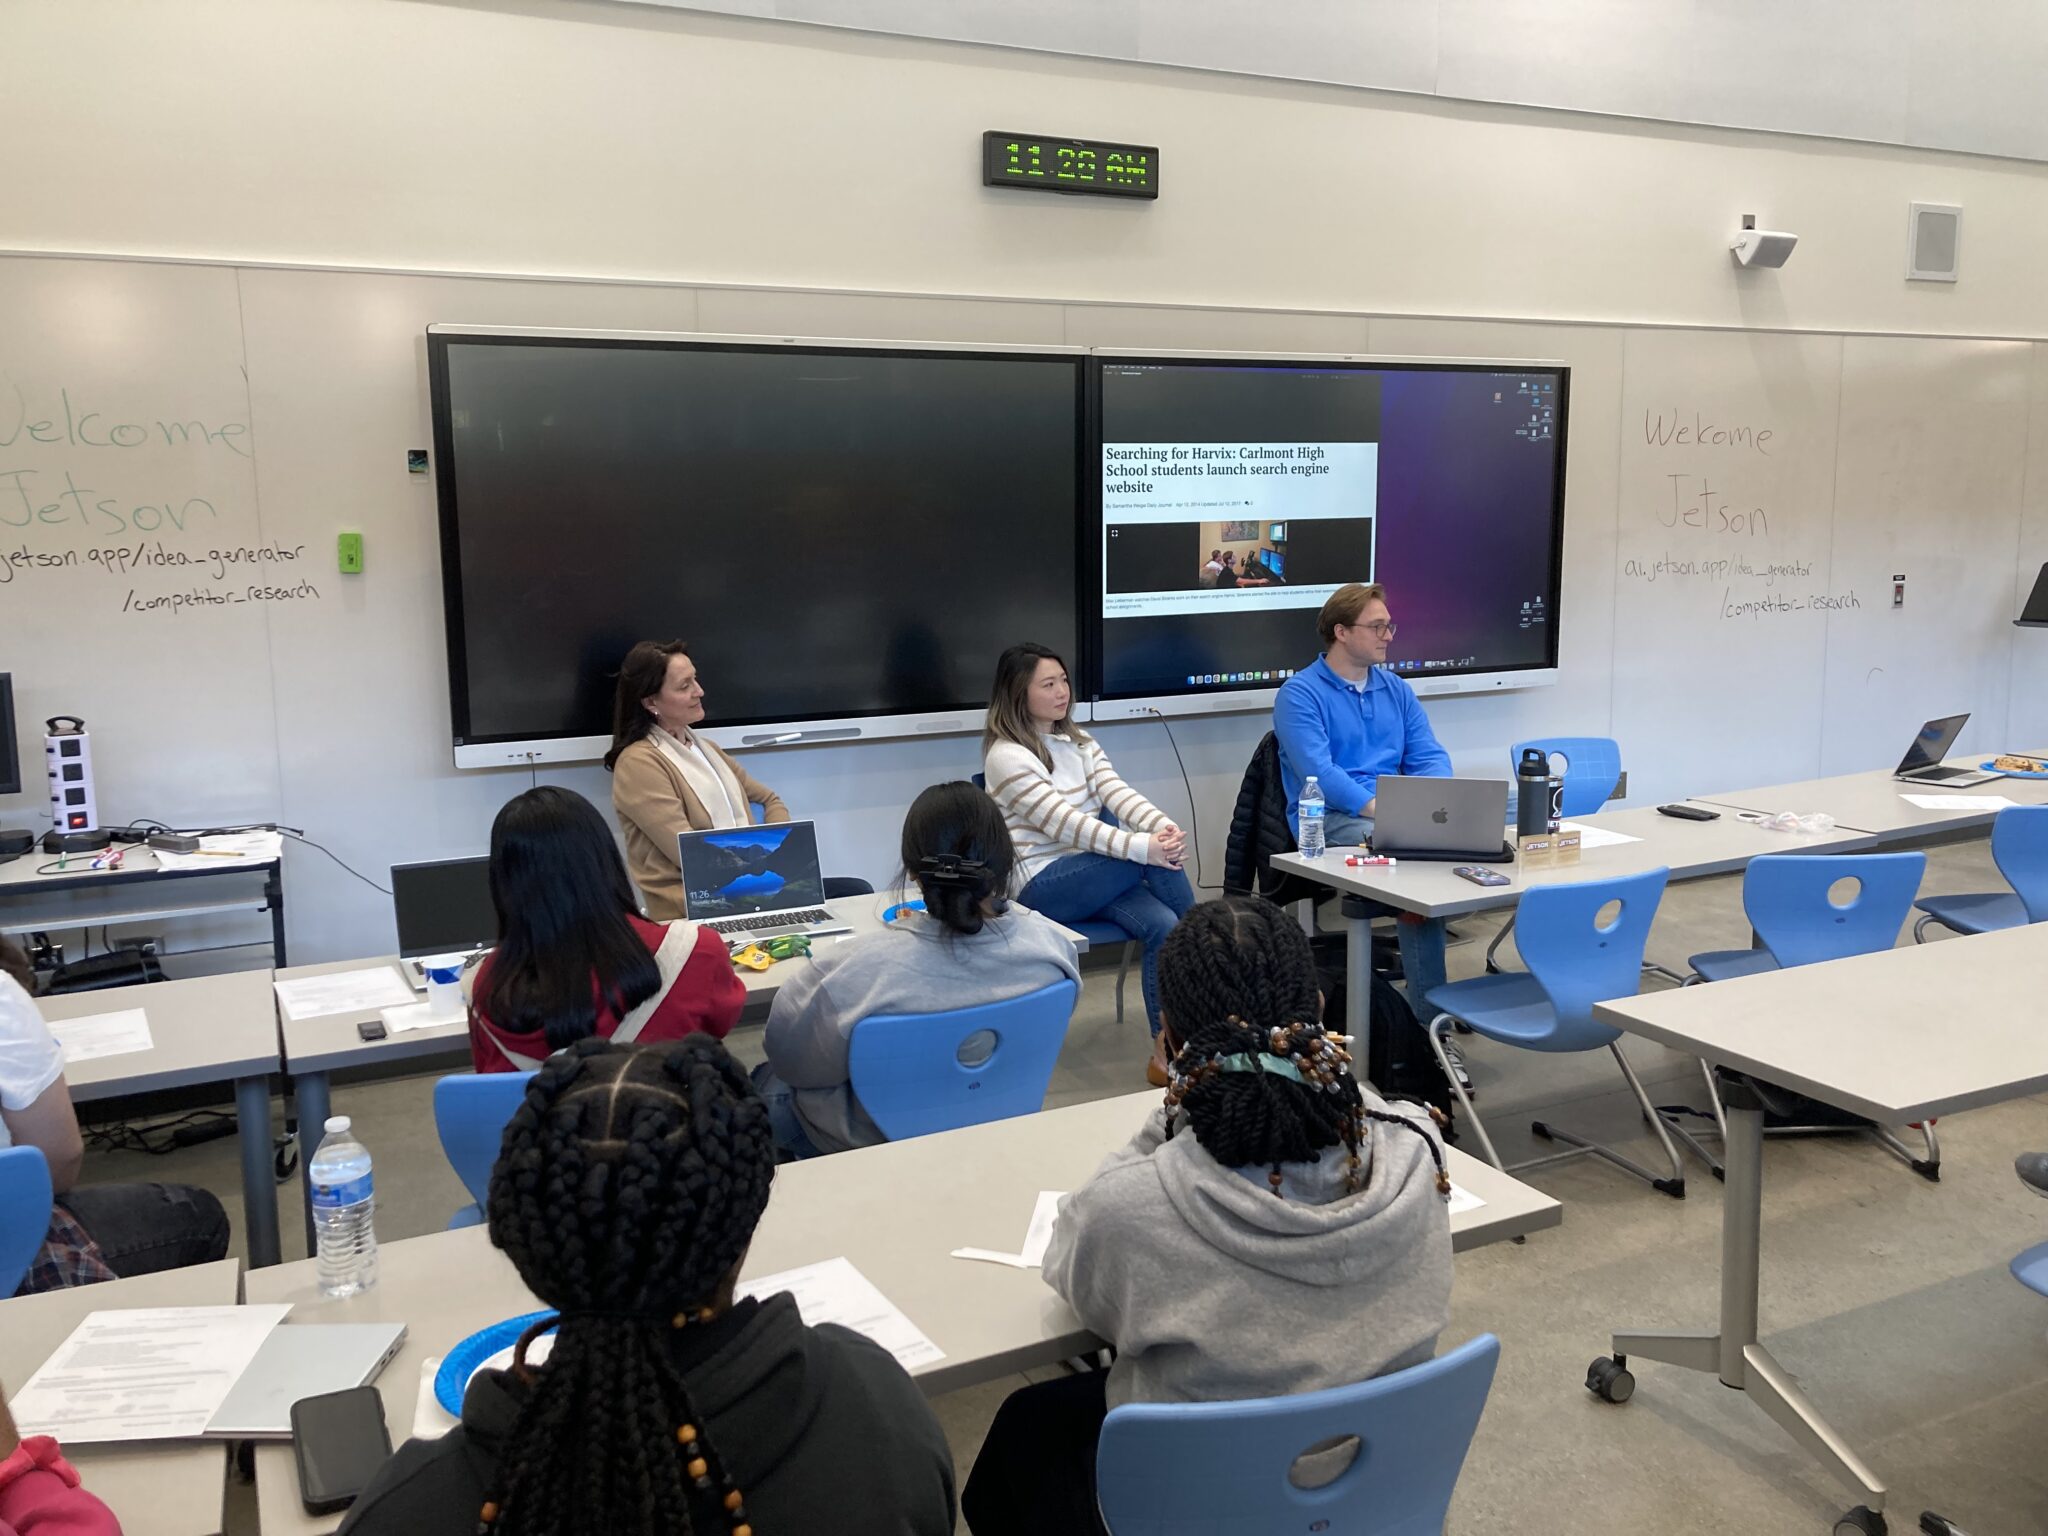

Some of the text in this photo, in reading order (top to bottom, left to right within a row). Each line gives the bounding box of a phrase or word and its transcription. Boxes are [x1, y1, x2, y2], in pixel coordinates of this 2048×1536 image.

[1106, 446, 1325, 462] Searching for Harvix: Carlmont High
[1106, 462, 1330, 477] School students launch search engine
[1106, 480, 1154, 493] website
[0, 470, 217, 536] Jetson
[1655, 473, 1769, 536] Jetson
